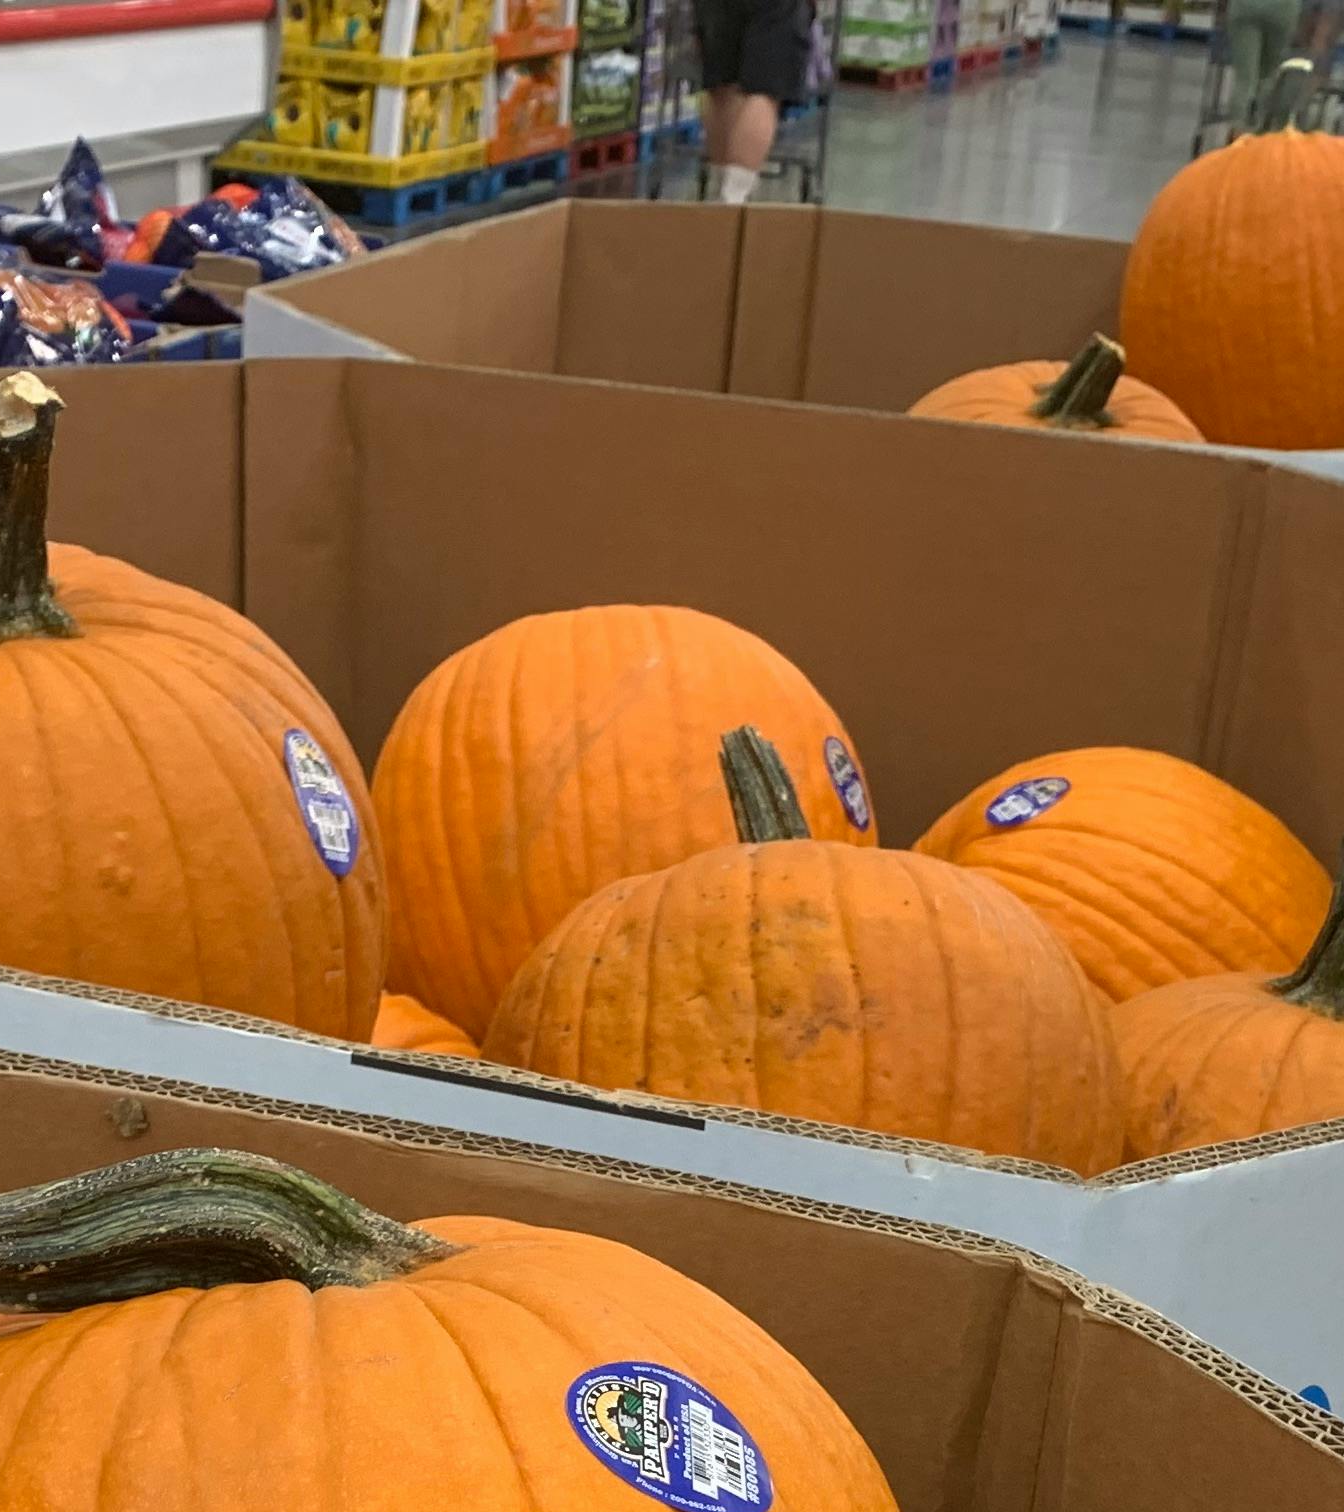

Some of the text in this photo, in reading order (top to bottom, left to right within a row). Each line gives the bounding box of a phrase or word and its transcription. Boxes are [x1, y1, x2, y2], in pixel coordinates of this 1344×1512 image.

[587, 1384, 624, 1452] PUMPKINS
[642, 1381, 664, 1475] PAMPER'D
[680, 1403, 692, 1480] Product of USA
